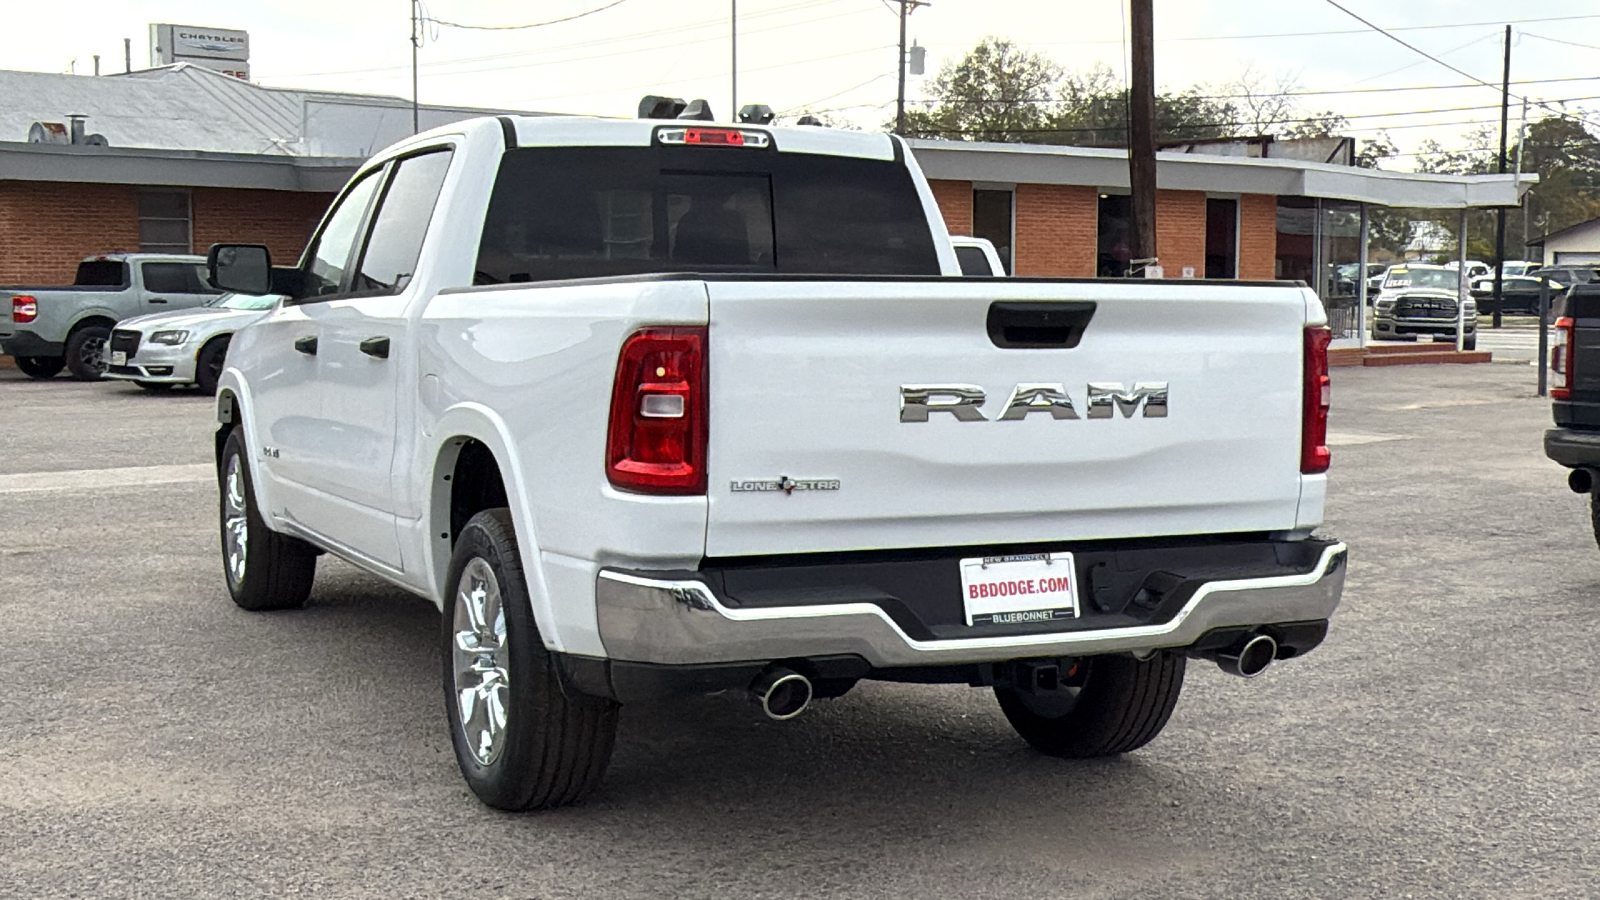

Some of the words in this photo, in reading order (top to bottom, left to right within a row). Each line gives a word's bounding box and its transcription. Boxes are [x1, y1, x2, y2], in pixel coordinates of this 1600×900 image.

[179, 32, 244, 43] CHRYSLER
[899, 381, 1169, 423] RAM
[731, 481, 778, 492] LONE
[795, 480, 840, 491] STAR
[968, 576, 1069, 599] BBDODGE.COM
[992, 610, 1054, 623] BLUEBONNET
